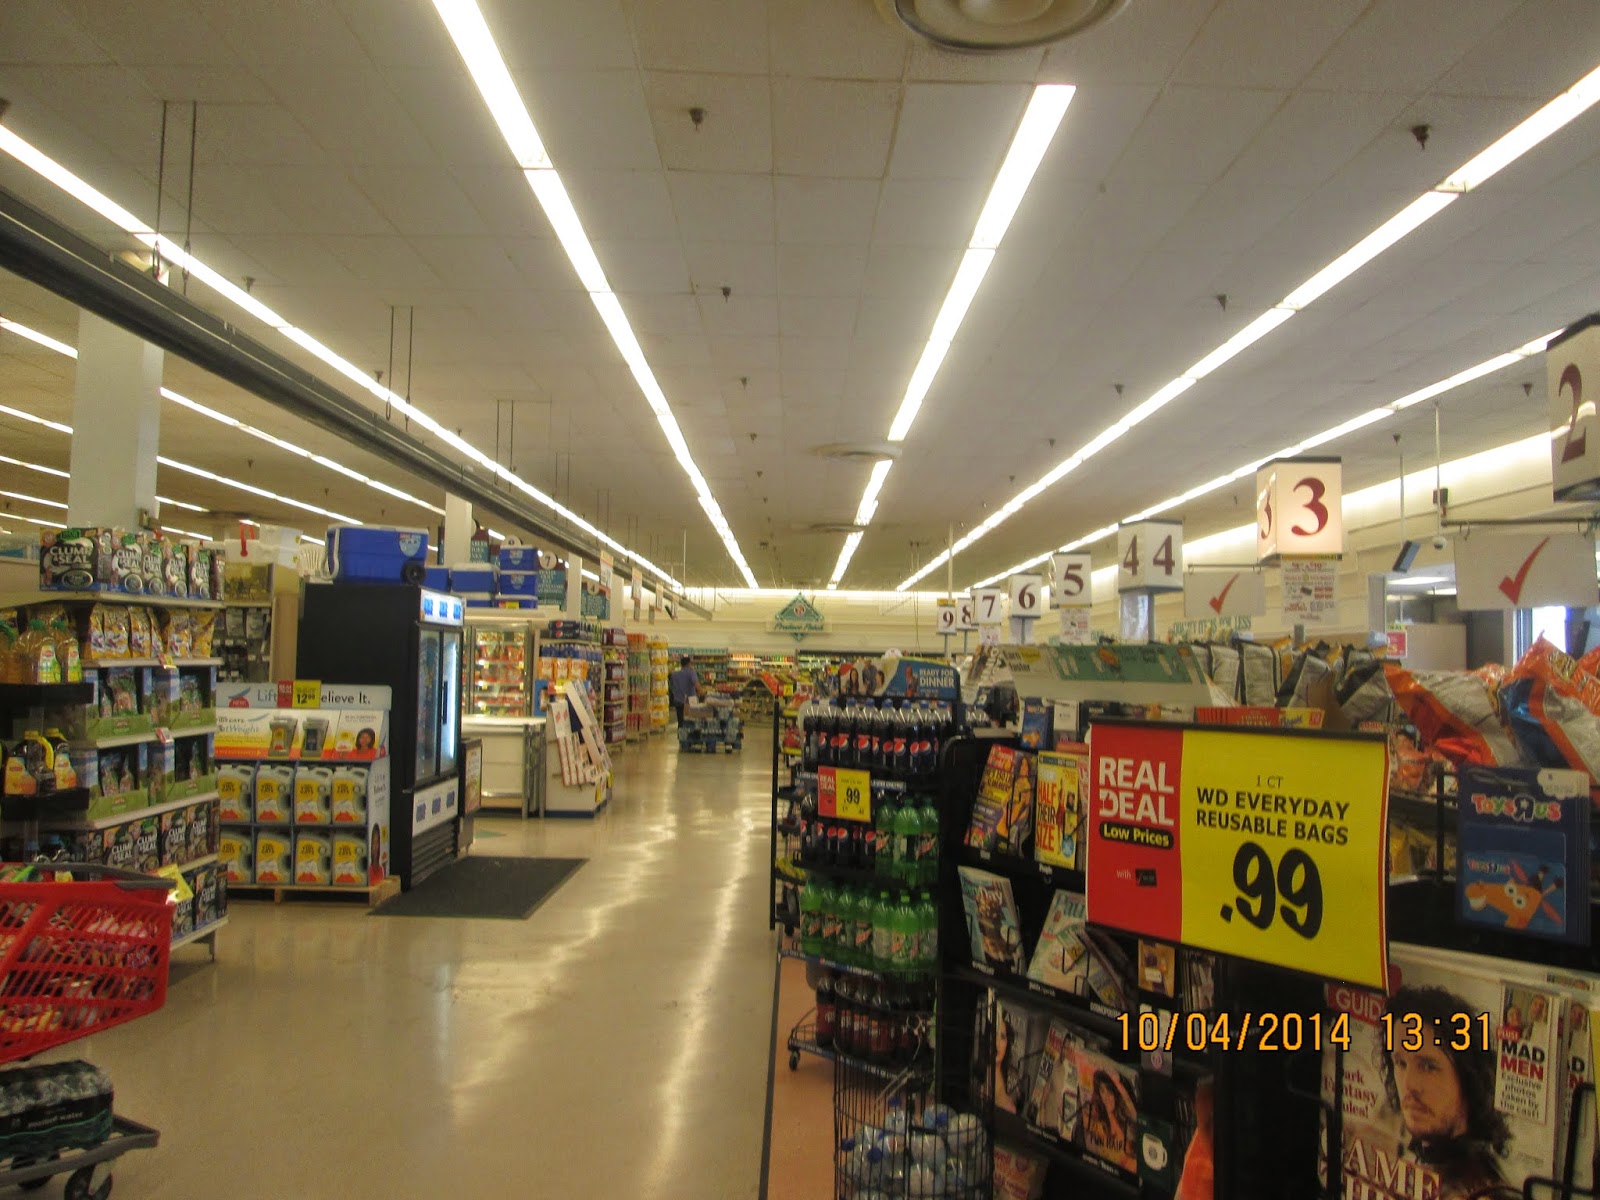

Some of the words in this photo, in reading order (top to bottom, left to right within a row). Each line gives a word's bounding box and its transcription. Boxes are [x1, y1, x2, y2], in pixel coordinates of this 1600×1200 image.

[1557, 362, 1587, 464] 2
[1291, 477, 1329, 537] 3
[58, 555, 88, 564] SEAL
[545, 555, 551, 567] 7
[1123, 534, 1140, 576] 4
[1152, 534, 1176, 576] 4
[1063, 563, 1084, 596] 5
[982, 595, 996, 618] 7
[1018, 582, 1036, 610] 6
[942, 610, 954, 628] 9
[919, 668, 939, 677] READY
[941, 669, 954, 677] FOR
[919, 676, 955, 688] DINNER
[257, 689, 278, 702] Lift
[321, 691, 355, 704] elieve
[359, 691, 371, 704] It.
[819, 775, 834, 783] REAL
[1099, 756, 1174, 793] REAL
[1256, 774, 1262, 787] 1
[1267, 775, 1284, 789] CT
[1099, 788, 1174, 826] DEAL
[1196, 787, 1228, 807] WD
[1235, 791, 1350, 821] EVERYDAY
[1103, 823, 1130, 841] Low
[1133, 827, 1170, 847] Prices
[1196, 809, 1287, 838] REUSABLE
[1294, 821, 1349, 846] BAGS
[1219, 840, 1324, 941] .99
[1335, 988, 1387, 1022] GUID
[1502, 1039, 1545, 1062] MAD
[1343, 1068, 1365, 1085] ark
[1500, 1055, 1544, 1081] MEN
[1501, 1072, 1542, 1090] Exclusive
[1505, 1083, 1537, 1099] photos
[1342, 1100, 1369, 1118] ules!
[1500, 1098, 1515, 1110] the
[1501, 1091, 1526, 1105] taken
[1528, 1098, 1539, 1109] by
